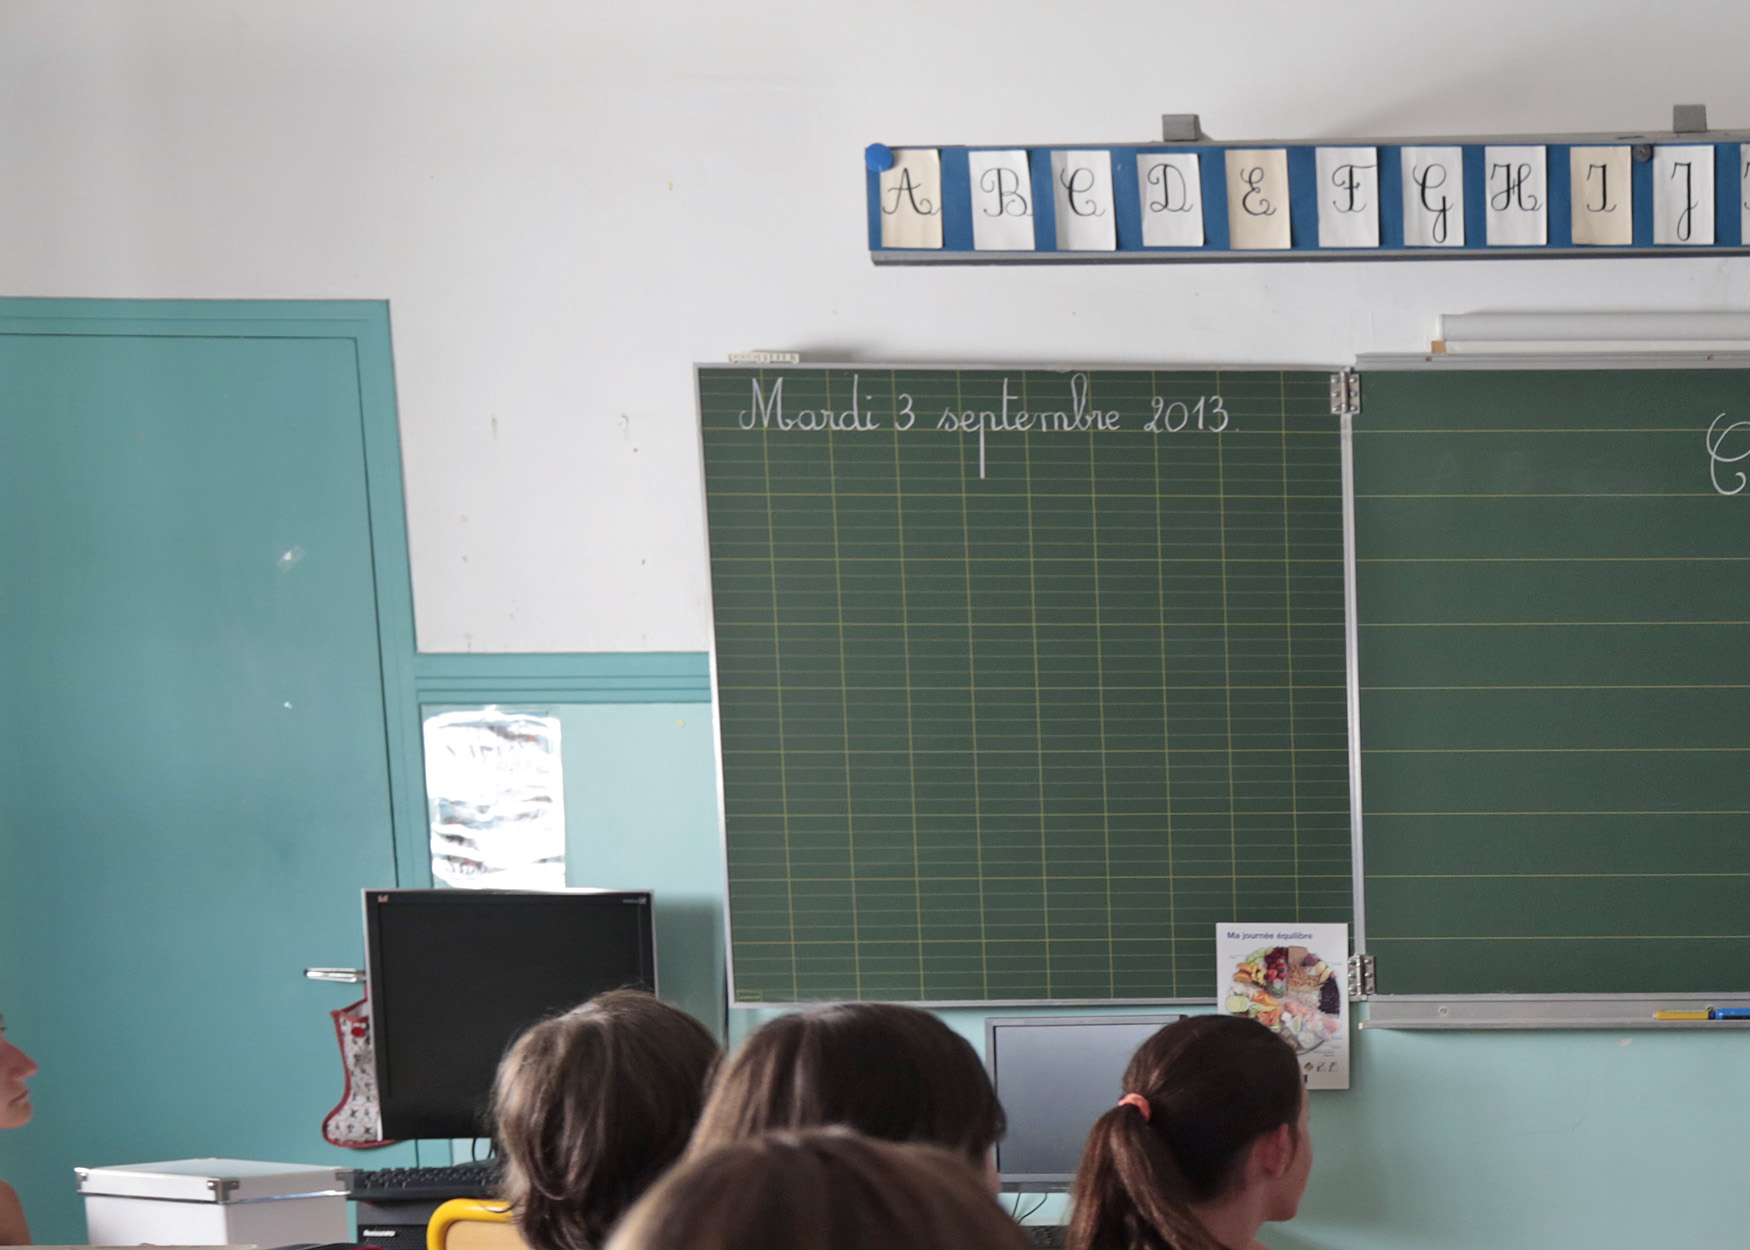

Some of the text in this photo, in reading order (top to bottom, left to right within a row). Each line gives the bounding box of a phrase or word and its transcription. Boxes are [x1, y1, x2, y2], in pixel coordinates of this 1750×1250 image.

[881, 167, 939, 216] A
[980, 167, 1033, 217] B
[1059, 168, 1106, 217] C
[1146, 163, 1193, 213] D
[1241, 166, 1277, 216] E
[1331, 164, 1377, 213] F
[1413, 163, 1454, 244] G
[1489, 163, 1543, 212] H
[1586, 163, 1617, 213] I
[1671, 161, 1699, 242] J
[740, 373, 880, 431] Mardi
[893, 395, 916, 432] 3
[936, 372, 1120, 479] septembre
